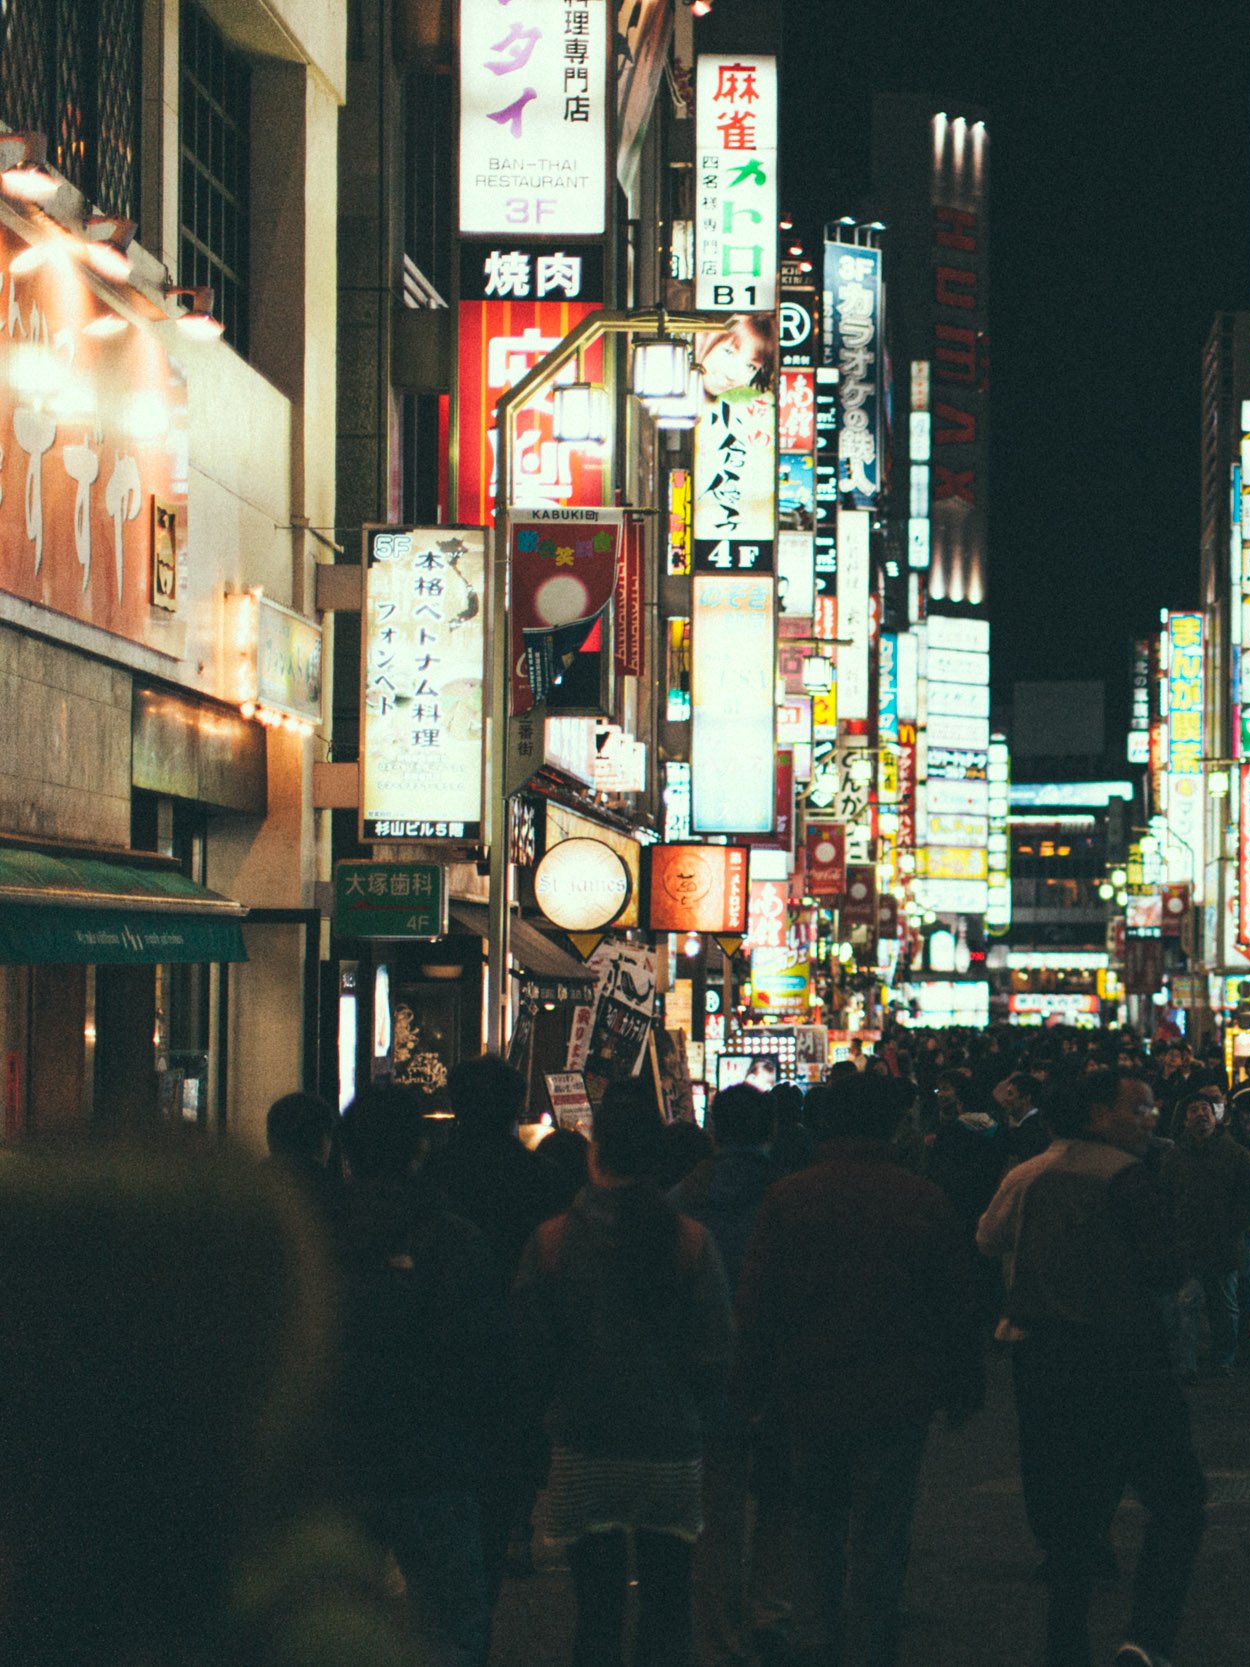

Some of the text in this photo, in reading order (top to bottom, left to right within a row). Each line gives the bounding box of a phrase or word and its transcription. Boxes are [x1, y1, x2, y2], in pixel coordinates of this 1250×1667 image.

[483, 0, 543, 139] タイ
[712, 63, 760, 150] 麻雀
[489, 158, 577, 171] BAN-THAI
[475, 176, 589, 189] RESTAURANT
[505, 198, 558, 224] 3F
[484, 251, 582, 297] 焼肉
[713, 285, 757, 305] B1
[375, 535, 412, 560] 5F
[707, 540, 760, 568] 4F
[411, 551, 445, 748] 本格ベトナム料理
[345, 872, 432, 896] 大塚歯科
[406, 915, 429, 931] 4F
